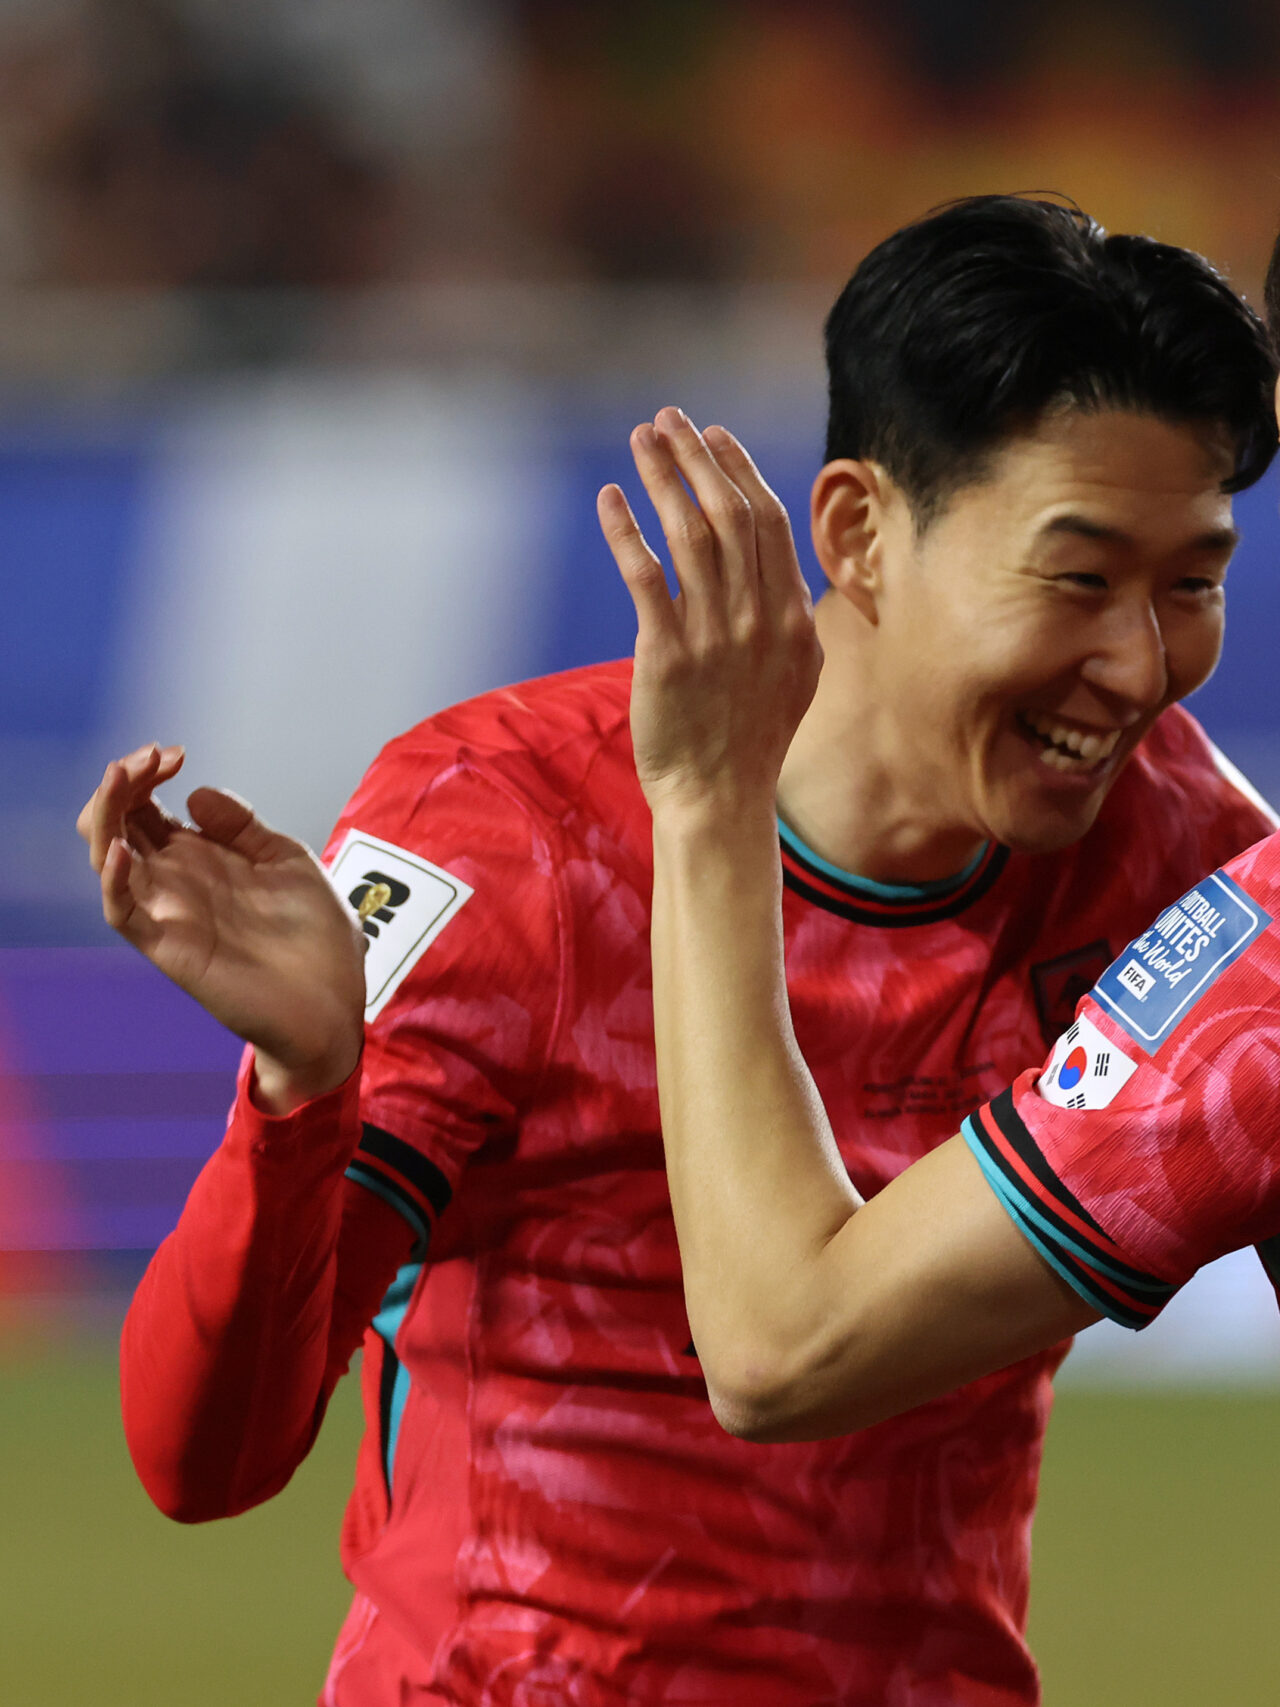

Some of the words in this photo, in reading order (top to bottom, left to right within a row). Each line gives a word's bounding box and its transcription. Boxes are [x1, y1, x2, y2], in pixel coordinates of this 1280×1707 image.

[1131, 930, 1150, 954] the
[1142, 938, 1193, 990] World
[1154, 905, 1211, 962] UNITES
[1123, 966, 1147, 992] FIFA
